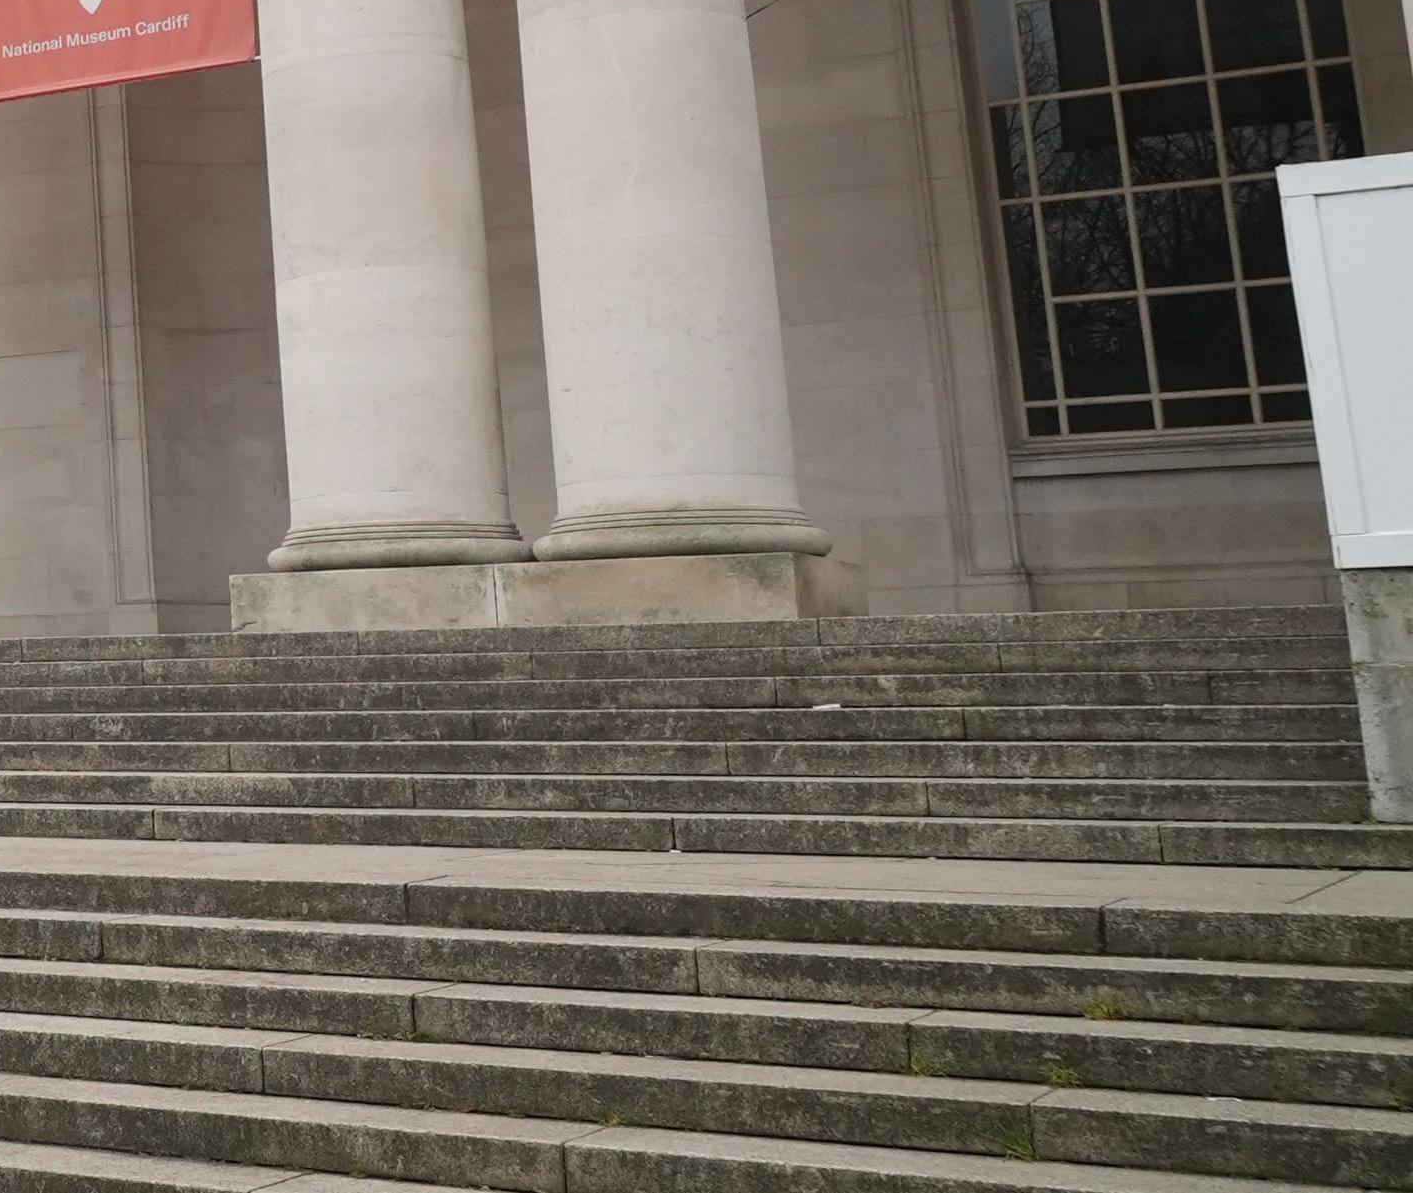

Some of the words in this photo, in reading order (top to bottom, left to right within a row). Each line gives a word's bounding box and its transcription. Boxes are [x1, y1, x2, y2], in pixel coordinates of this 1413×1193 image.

[1, 38, 63, 59] National
[66, 27, 131, 48] Museum
[135, 14, 190, 36] Cardiff
